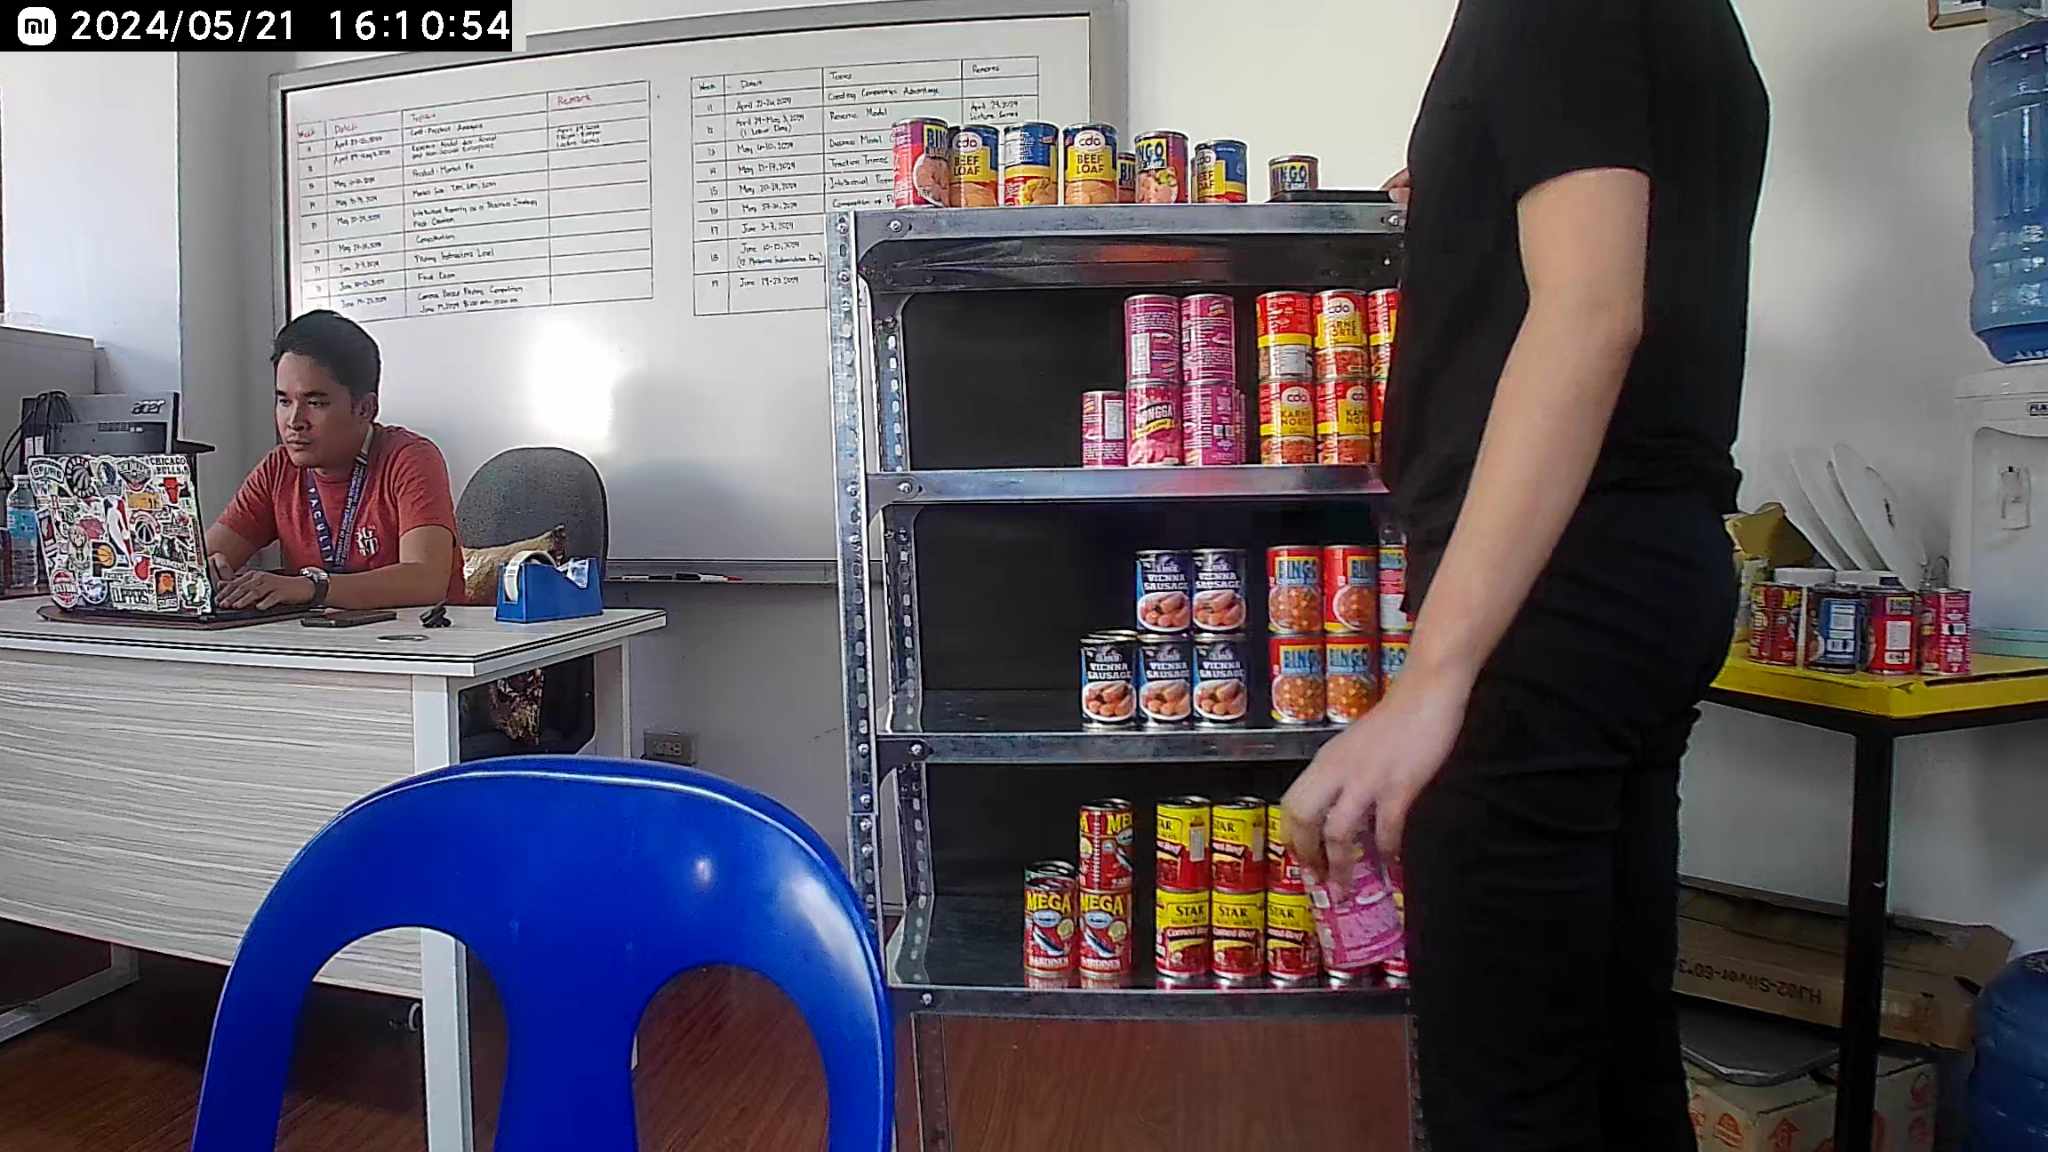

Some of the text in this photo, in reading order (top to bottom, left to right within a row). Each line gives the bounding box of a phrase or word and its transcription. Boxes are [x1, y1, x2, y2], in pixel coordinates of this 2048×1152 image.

[954, 155, 979, 167] BEEF
[1077, 153, 1104, 164] BEEF
[953, 166, 981, 176] LOAF
[1076, 164, 1105, 175] LOAF
[131, 400, 166, 415] acer
[1147, 573, 1186, 583] VIENNA
[1197, 572, 1237, 582] VIENNA
[1143, 582, 1189, 591] SAUSAGE
[1195, 580, 1241, 589] SAUSAGE
[1089, 662, 1128, 672] VIENNA
[1149, 661, 1188, 671] VIENNA
[1202, 660, 1241, 670] VIENNA
[1087, 670, 1132, 680] SAUSAGE
[1146, 669, 1190, 679] SAUSAGE
[1199, 668, 1245, 678] SAUSAGE
[1025, 892, 1072, 912] MEGA
[1079, 893, 1124, 914] MEGA
[1176, 905, 1204, 917] STAR
[1218, 906, 1249, 918] STAR
